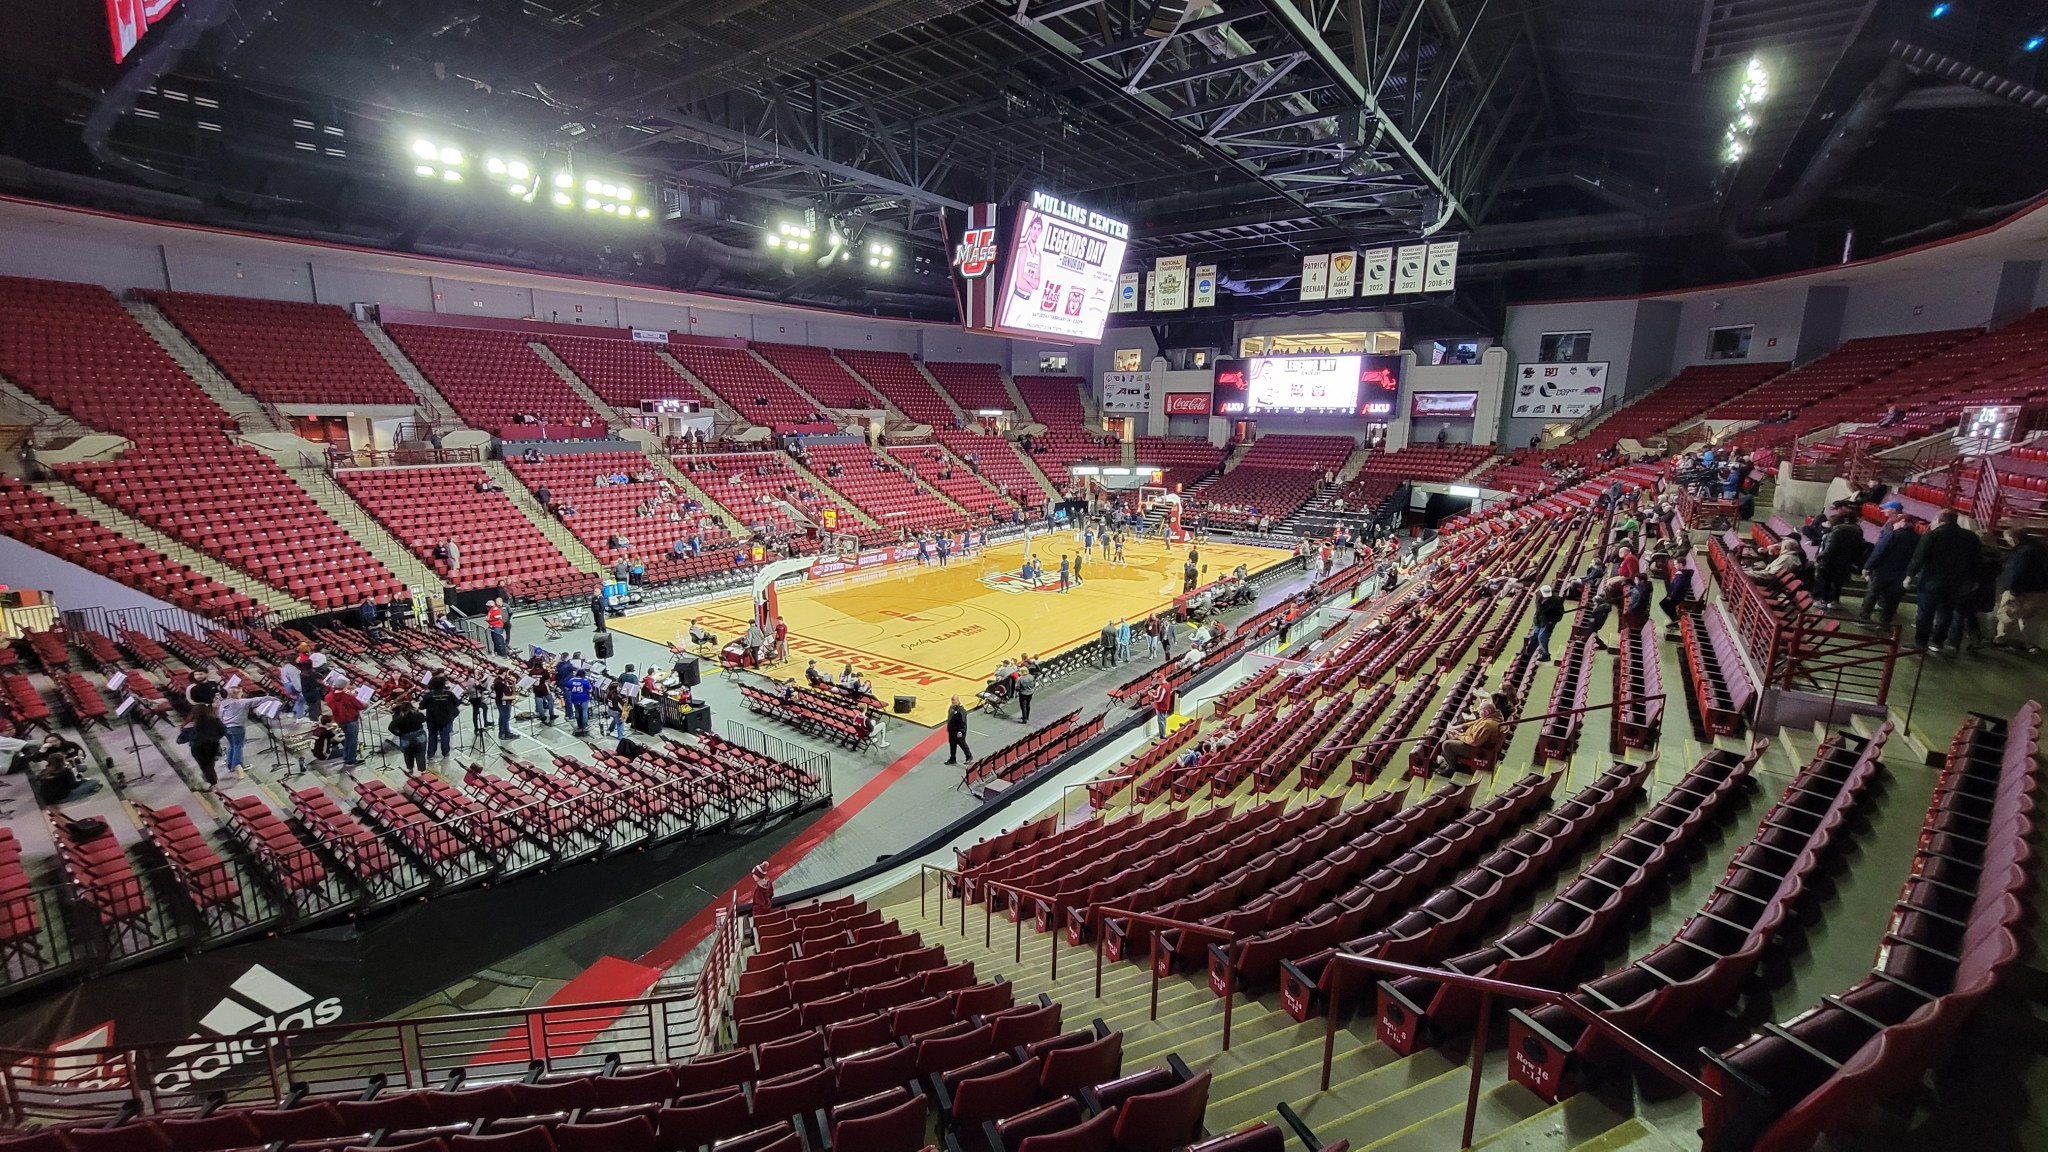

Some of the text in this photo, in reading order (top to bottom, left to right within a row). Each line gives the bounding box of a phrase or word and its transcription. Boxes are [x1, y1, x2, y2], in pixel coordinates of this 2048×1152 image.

[1033, 191, 1129, 240] MULLINS CENTER
[1044, 225, 1107, 265] LEGENDS DAY
[1304, 262, 1327, 270] PATRICK
[1311, 272, 1317, 282] 4
[1219, 402, 1244, 413] ALKU
[1362, 403, 1390, 414] ALKU
[1551, 405, 1562, 413] N
[826, 518, 836, 528] 30
[927, 624, 983, 644] LEAMAN
[1211, 970, 1220, 982] Row
[1284, 989, 1295, 1002] Row
[1287, 999, 1299, 1013] 1-12
[1516, 1051, 1549, 1081] Row 16
[1521, 1064, 1542, 1085] 1-14
